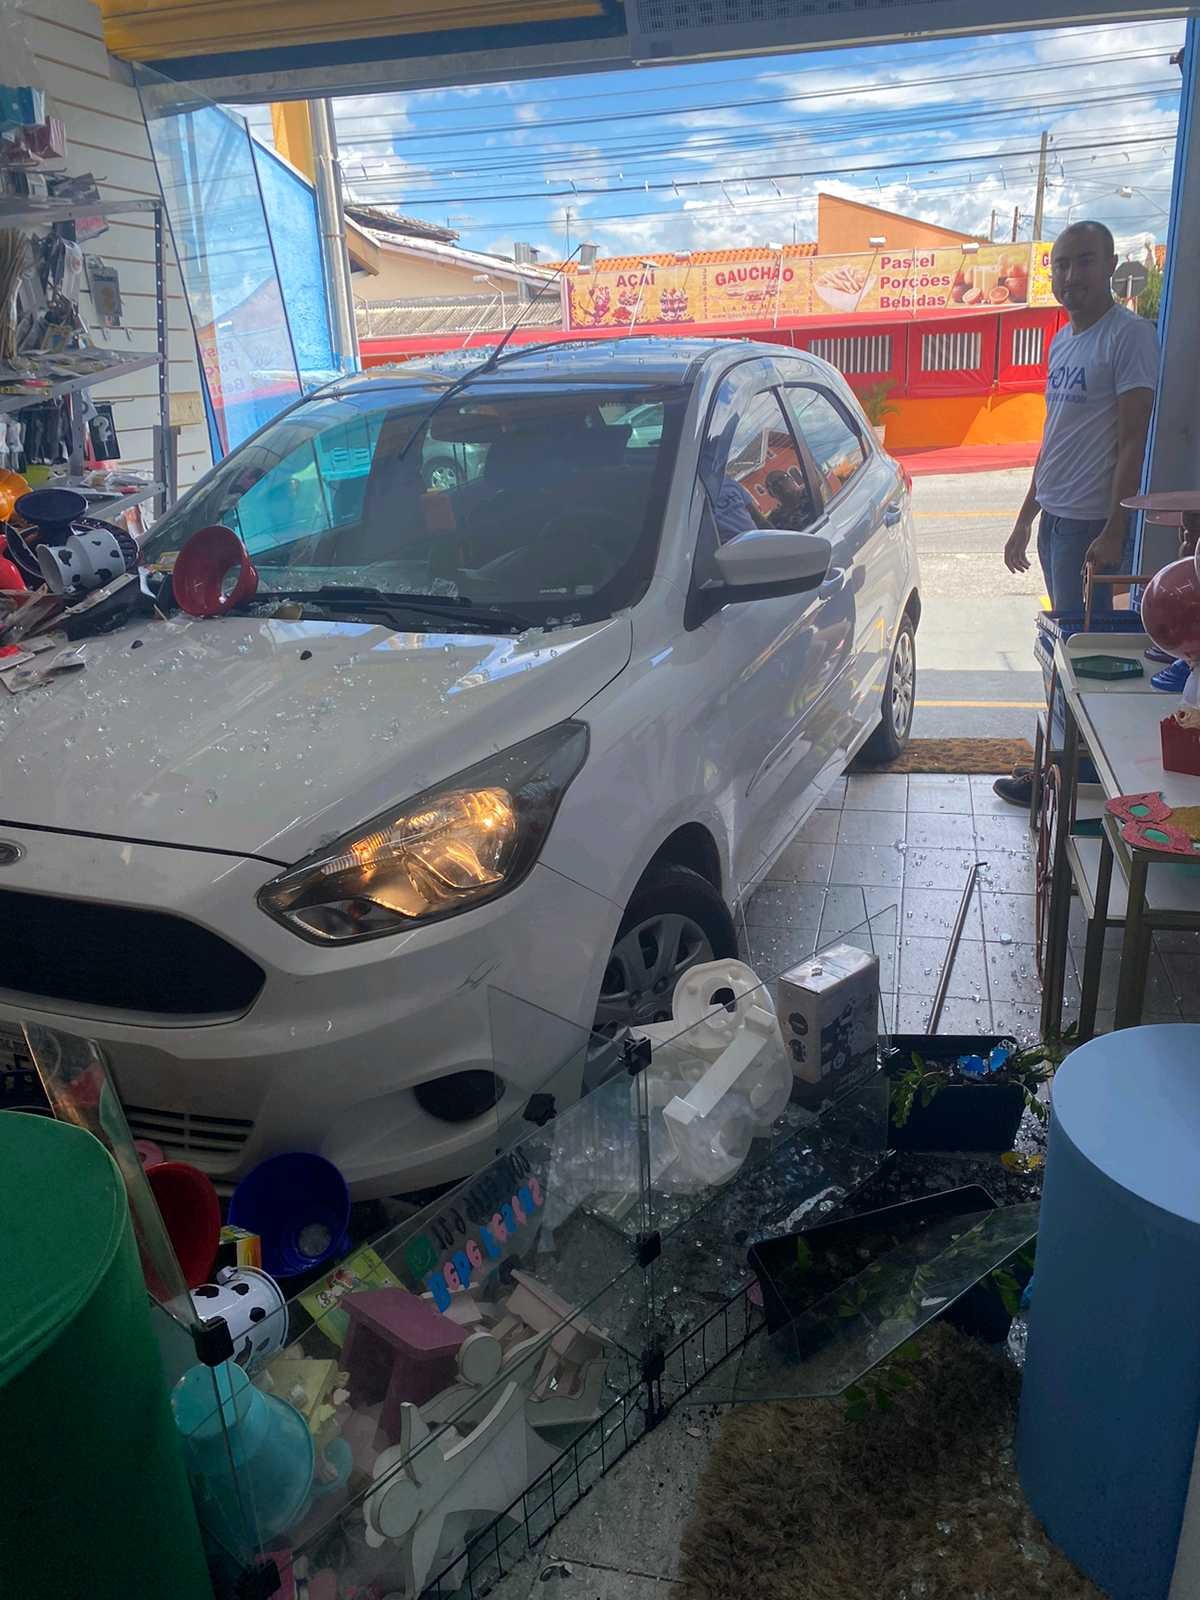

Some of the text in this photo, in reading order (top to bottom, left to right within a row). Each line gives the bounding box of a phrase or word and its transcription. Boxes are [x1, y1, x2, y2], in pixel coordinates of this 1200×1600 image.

[616, 268, 656, 288] AÇAÍ
[880, 274, 951, 290] Porções
[880, 295, 947, 310] Bebidas
